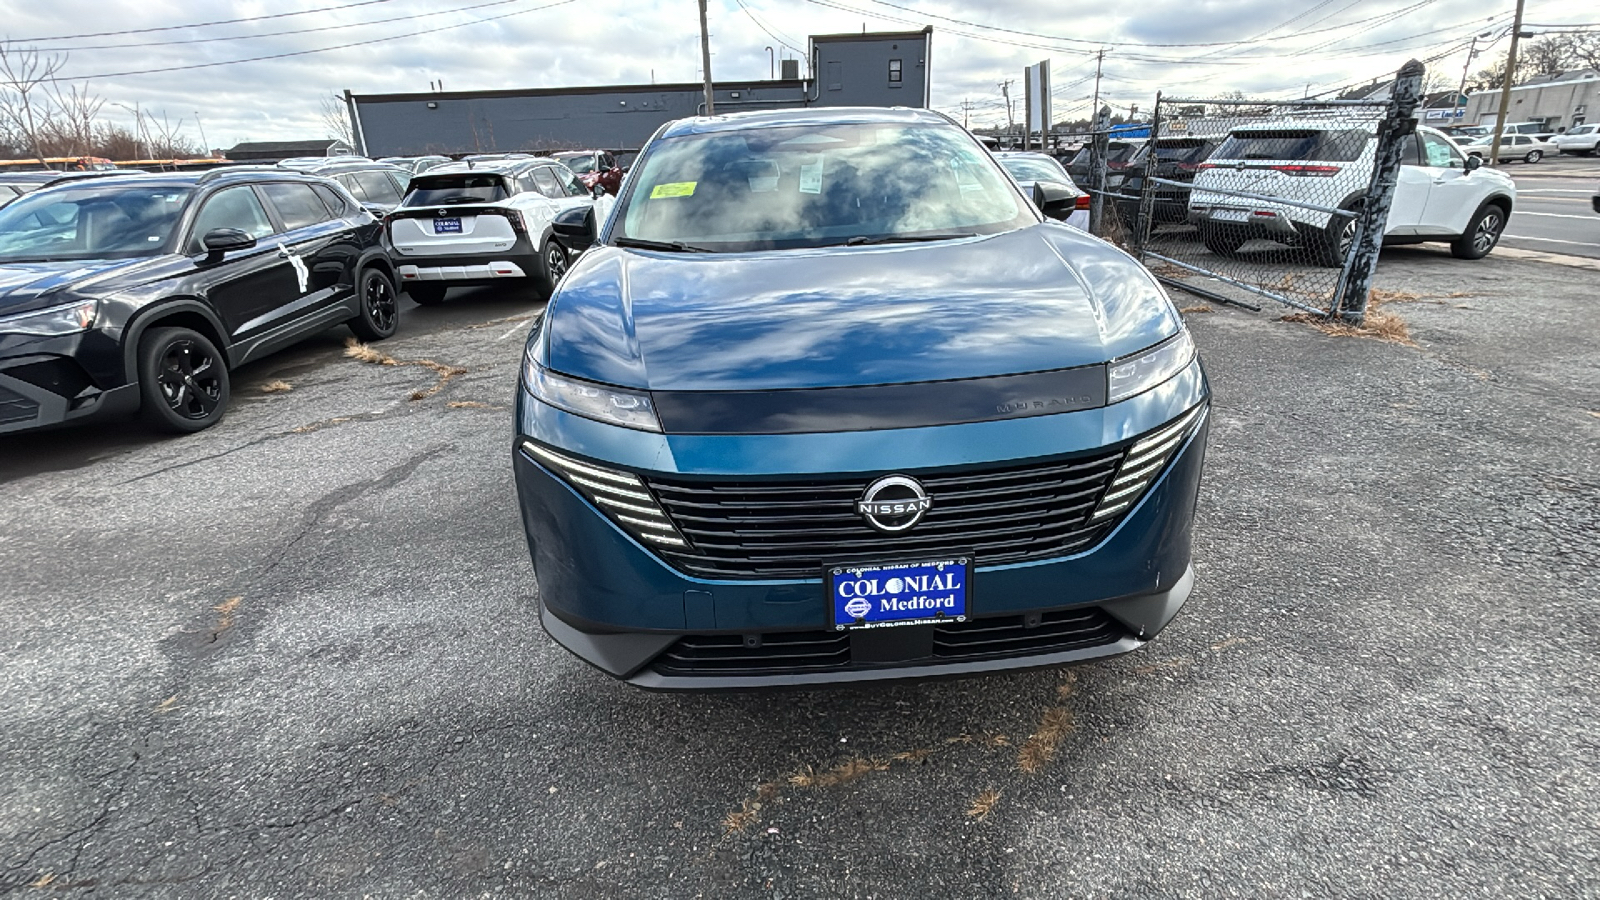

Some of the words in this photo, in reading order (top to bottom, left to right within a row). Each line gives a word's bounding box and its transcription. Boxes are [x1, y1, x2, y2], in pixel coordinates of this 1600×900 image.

[996, 395, 1091, 413] MURANO
[860, 499, 930, 514] NISSAN
[846, 566, 881, 574] COLONIAL
[921, 560, 955, 568] MEDFORD
[838, 573, 960, 597] COLONIAL
[880, 594, 955, 612] Medford
